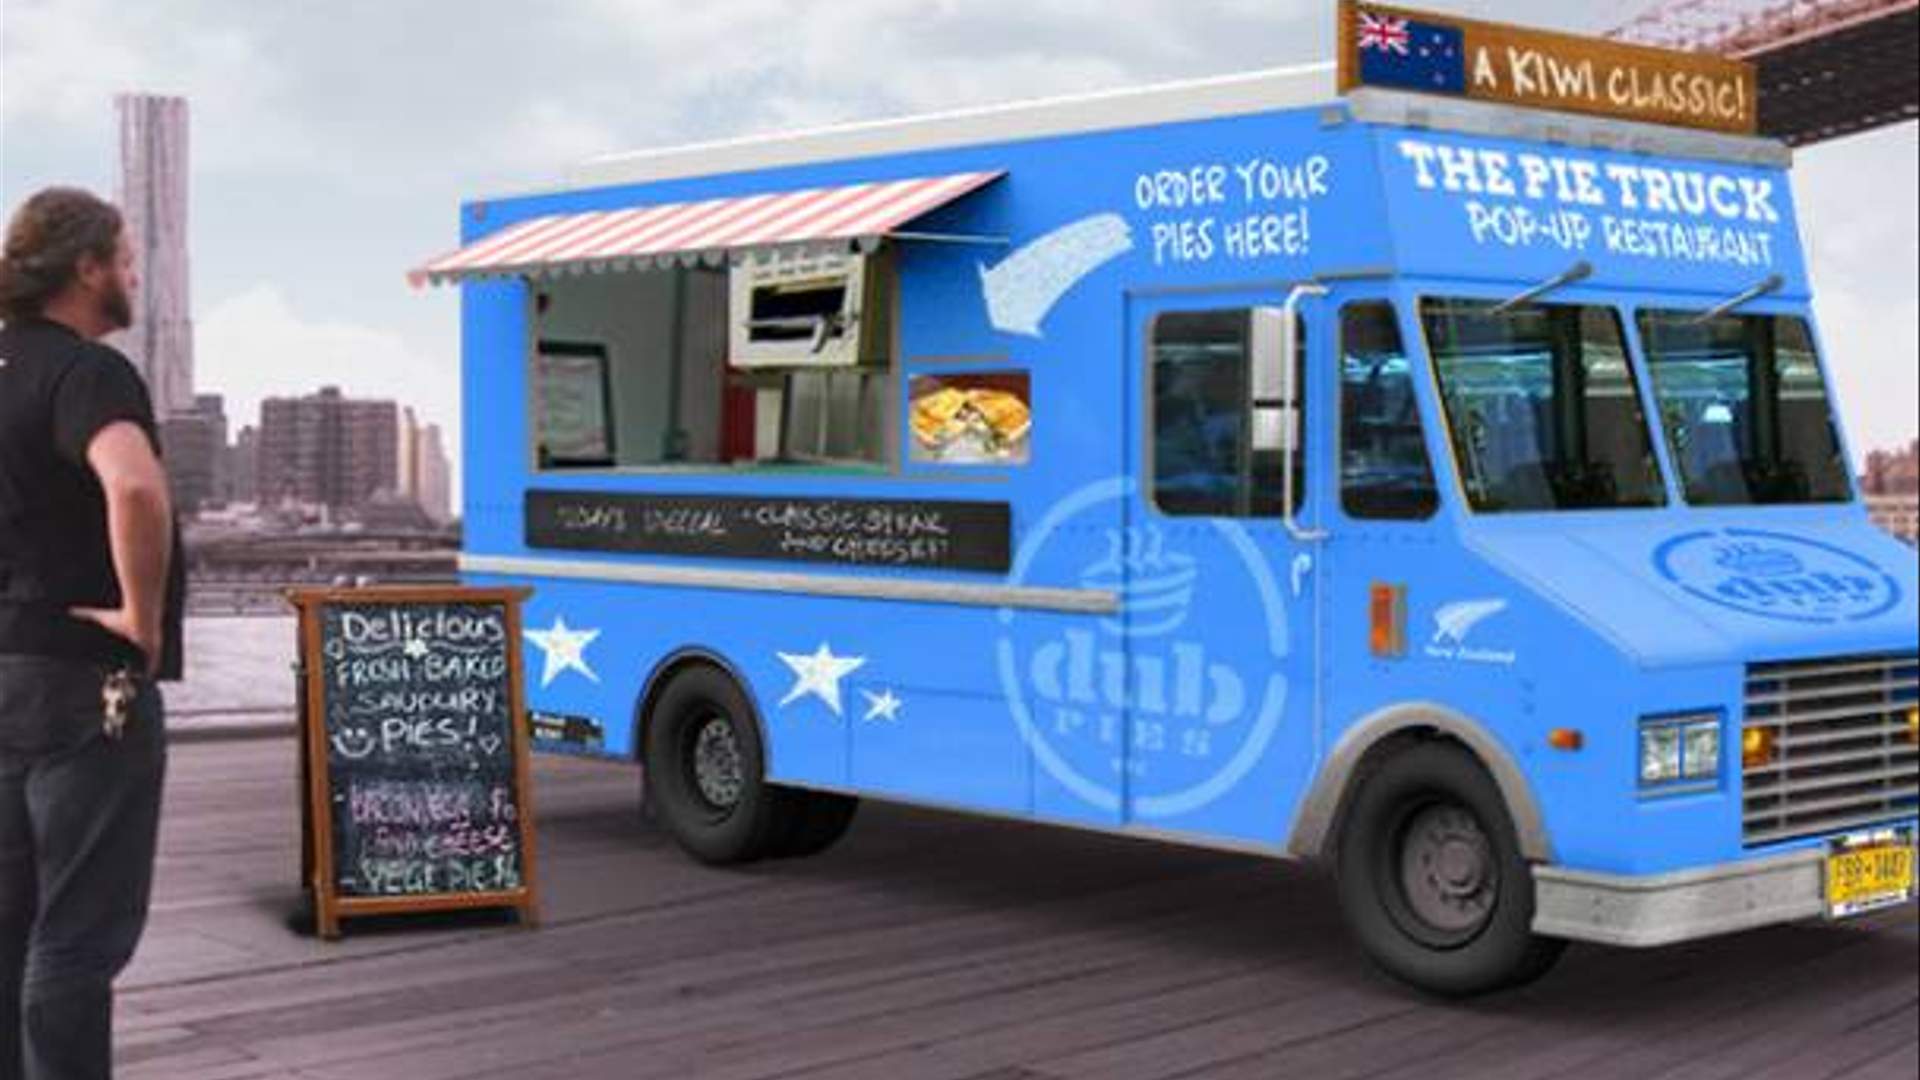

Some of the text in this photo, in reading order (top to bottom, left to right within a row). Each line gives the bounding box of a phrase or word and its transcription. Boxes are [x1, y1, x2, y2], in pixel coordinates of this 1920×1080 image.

[1473, 45, 1745, 121] A KIWI CLASSIC!
[1135, 154, 1330, 210] ORDER YOUR
[1397, 140, 1780, 224] THE PIE TRUCK
[1152, 205, 1310, 265] PIES HERE!
[1465, 202, 1773, 268] POP-UP RESTAURANT
[341, 610, 505, 643] Delicious
[1030, 628, 1246, 725] dub
